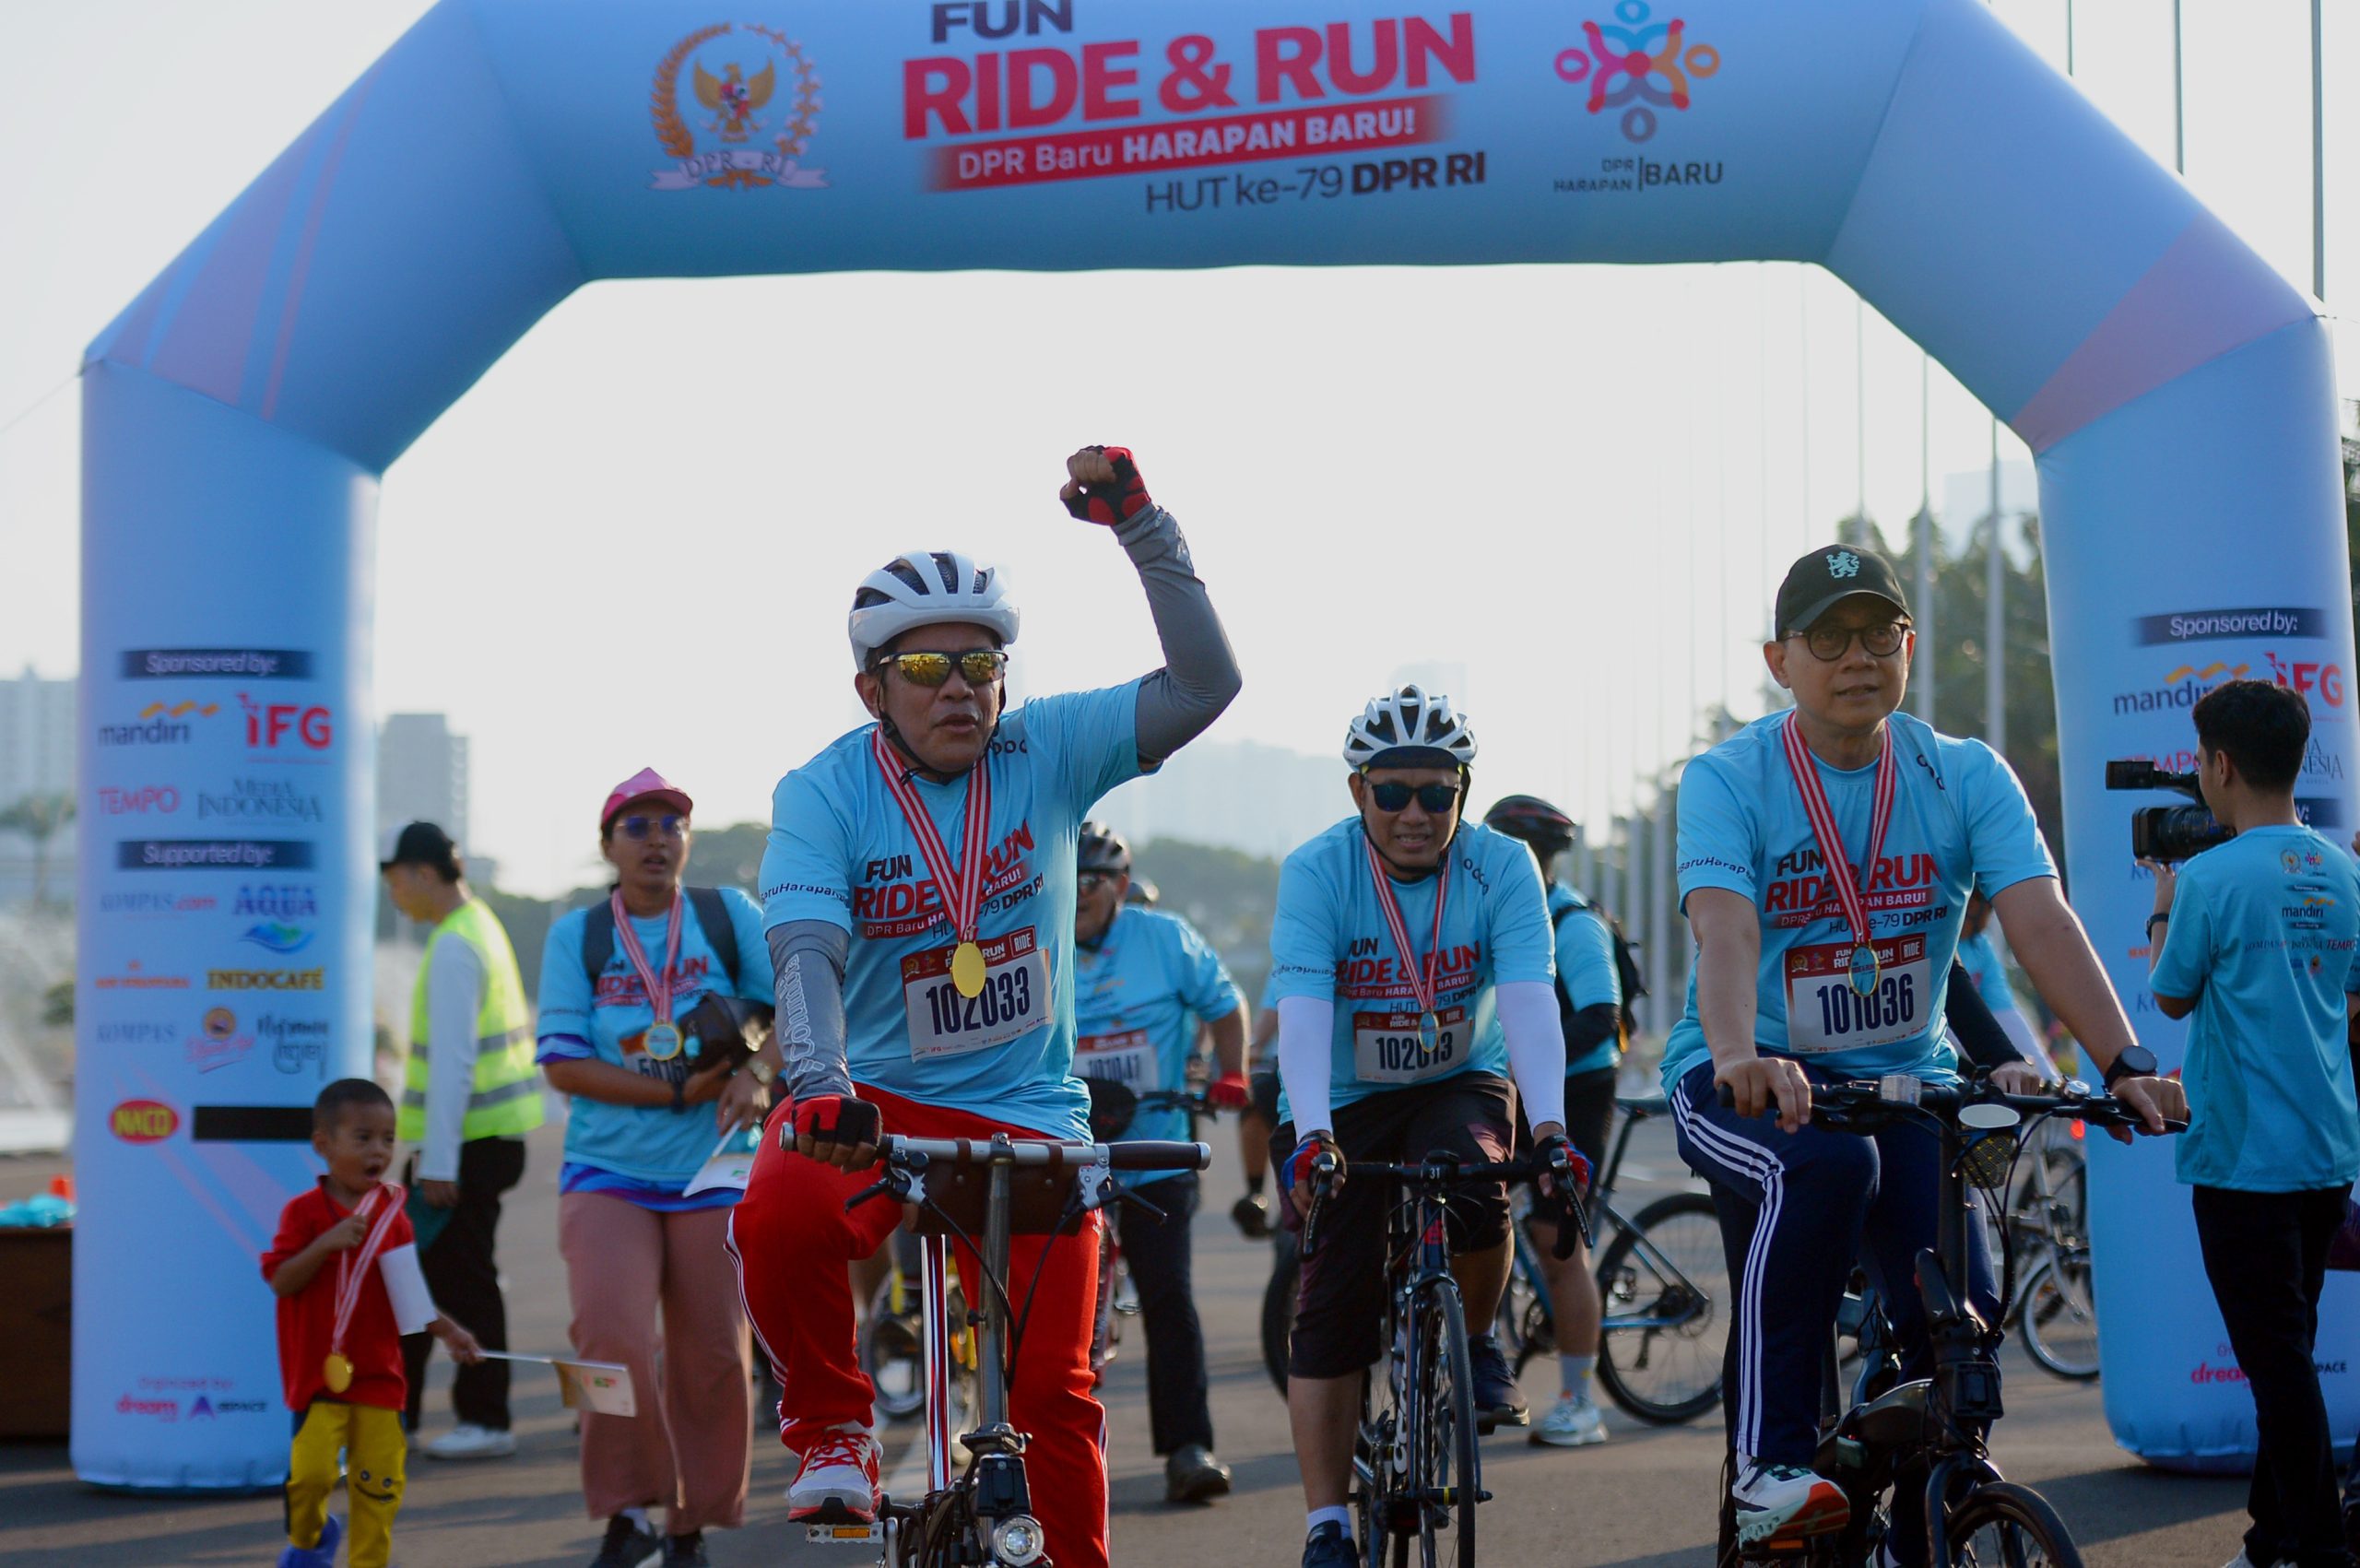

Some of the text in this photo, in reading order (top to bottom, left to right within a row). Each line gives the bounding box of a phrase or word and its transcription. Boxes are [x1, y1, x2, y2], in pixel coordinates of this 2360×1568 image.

[932, 0, 1073, 42] FUN
[903, 13, 1476, 139] RIDE & RUN
[959, 107, 1416, 181] DPR Baru HARAPAN BARU!
[1601, 159, 1634, 173] DPR
[1646, 161, 1723, 186] BARU
[1146, 151, 1486, 214] HUT ke-79 DPR RI
[2170, 610, 2298, 638] Sponsored by:
[146, 654, 277, 677] Sponsored by:
[98, 786, 181, 816] TEMPO
[143, 843, 273, 867] Supported by:
[1777, 849, 1824, 877] FUN
[853, 819, 1034, 919] RIDE RUN
[866, 855, 913, 883] FUN
[1869, 854, 1943, 890] RUN
[1002, 884, 1033, 911] DPR
[1886, 892, 1927, 905] BARU!
[2282, 904, 2324, 918] mandiri
[867, 923, 892, 937] DPR
[896, 921, 926, 934] Baru
[1829, 921, 1849, 934] HU
[1870, 913, 1900, 929] e-79
[1903, 907, 1934, 926] DPR
[1013, 933, 1032, 952] RIDE
[1835, 949, 1852, 958] FUN
[1903, 942, 1920, 959] RIDE
[1336, 957, 1392, 984] RIDE
[1422, 940, 1481, 978] RUN
[1360, 986, 1383, 996] Baru
[1437, 974, 1470, 990] BARU!
[926, 966, 1031, 1036] 102033
[1390, 1000, 1416, 1013] HUT
[1446, 1009, 1461, 1020] RIDE
[1817, 973, 1914, 1036] 101036
[1430, 1167, 1441, 1179] 31
